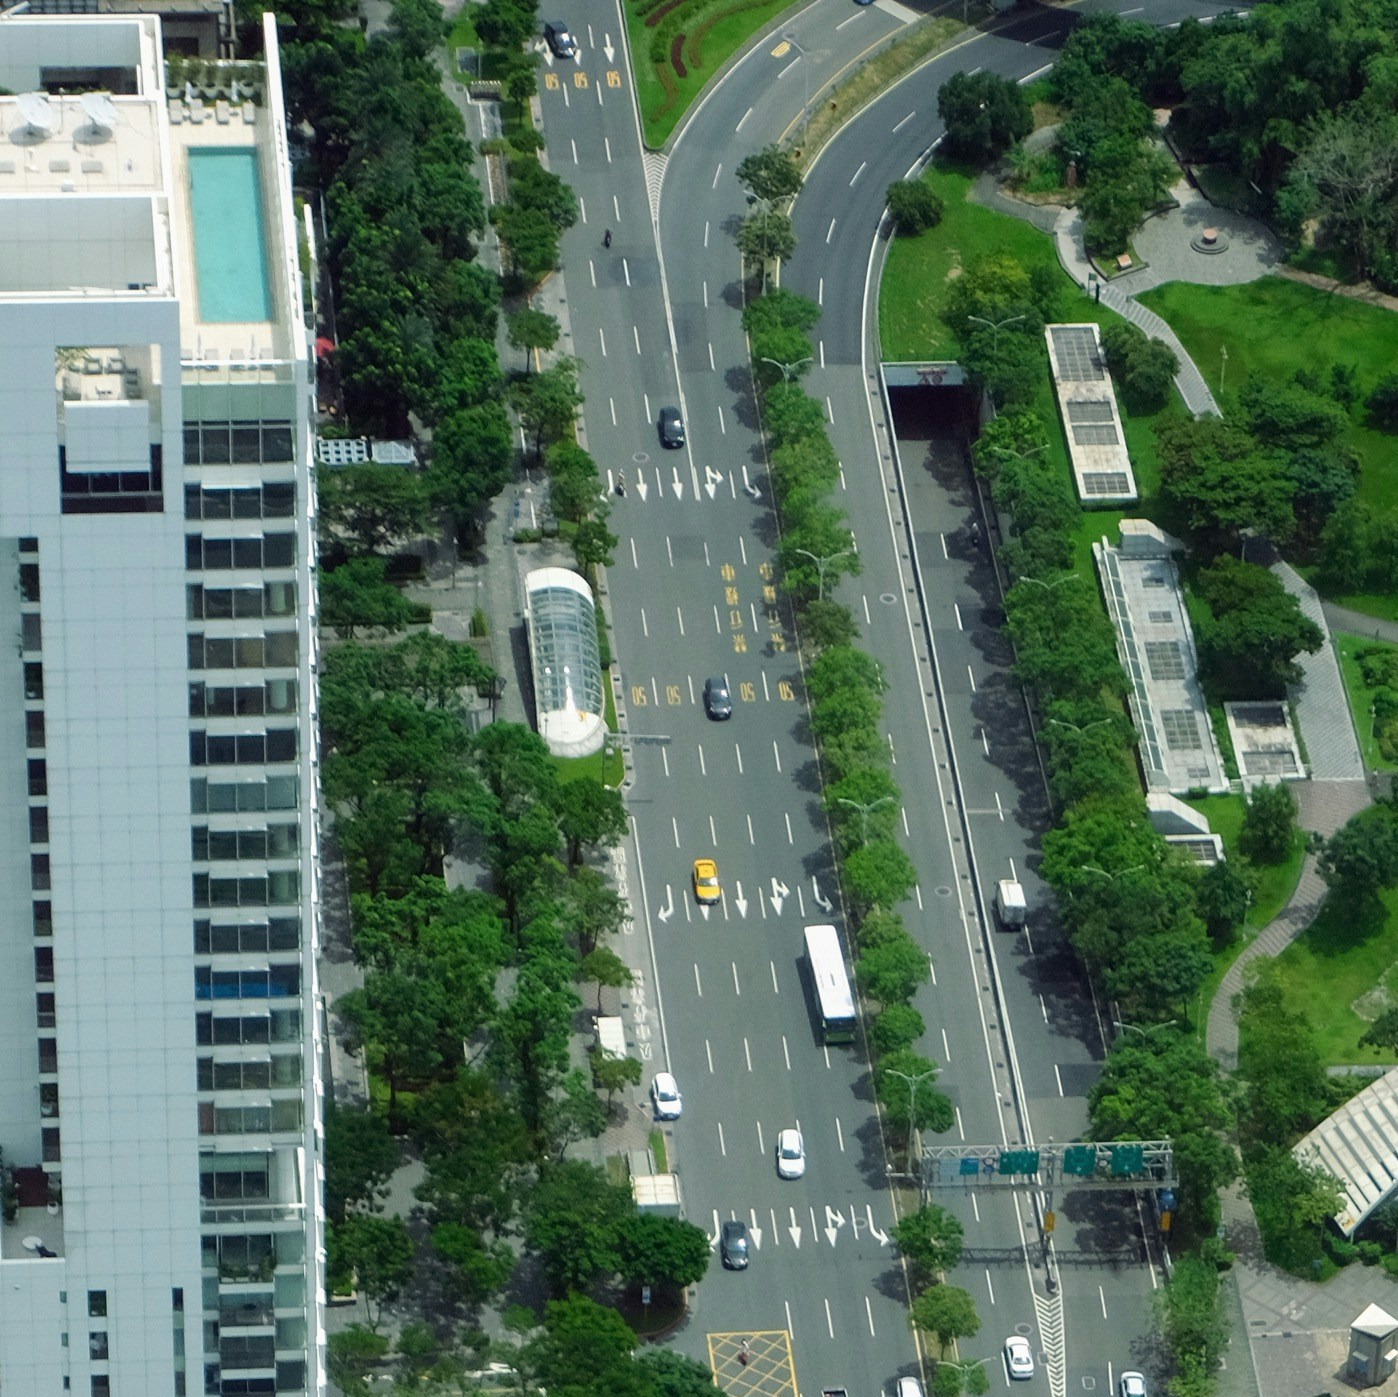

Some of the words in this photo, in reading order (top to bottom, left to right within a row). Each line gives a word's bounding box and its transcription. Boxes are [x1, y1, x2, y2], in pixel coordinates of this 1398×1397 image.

[631, 686, 648, 706] 50
[666, 685, 682, 705] 50
[740, 682, 756, 702] 50
[778, 680, 795, 701] 50
